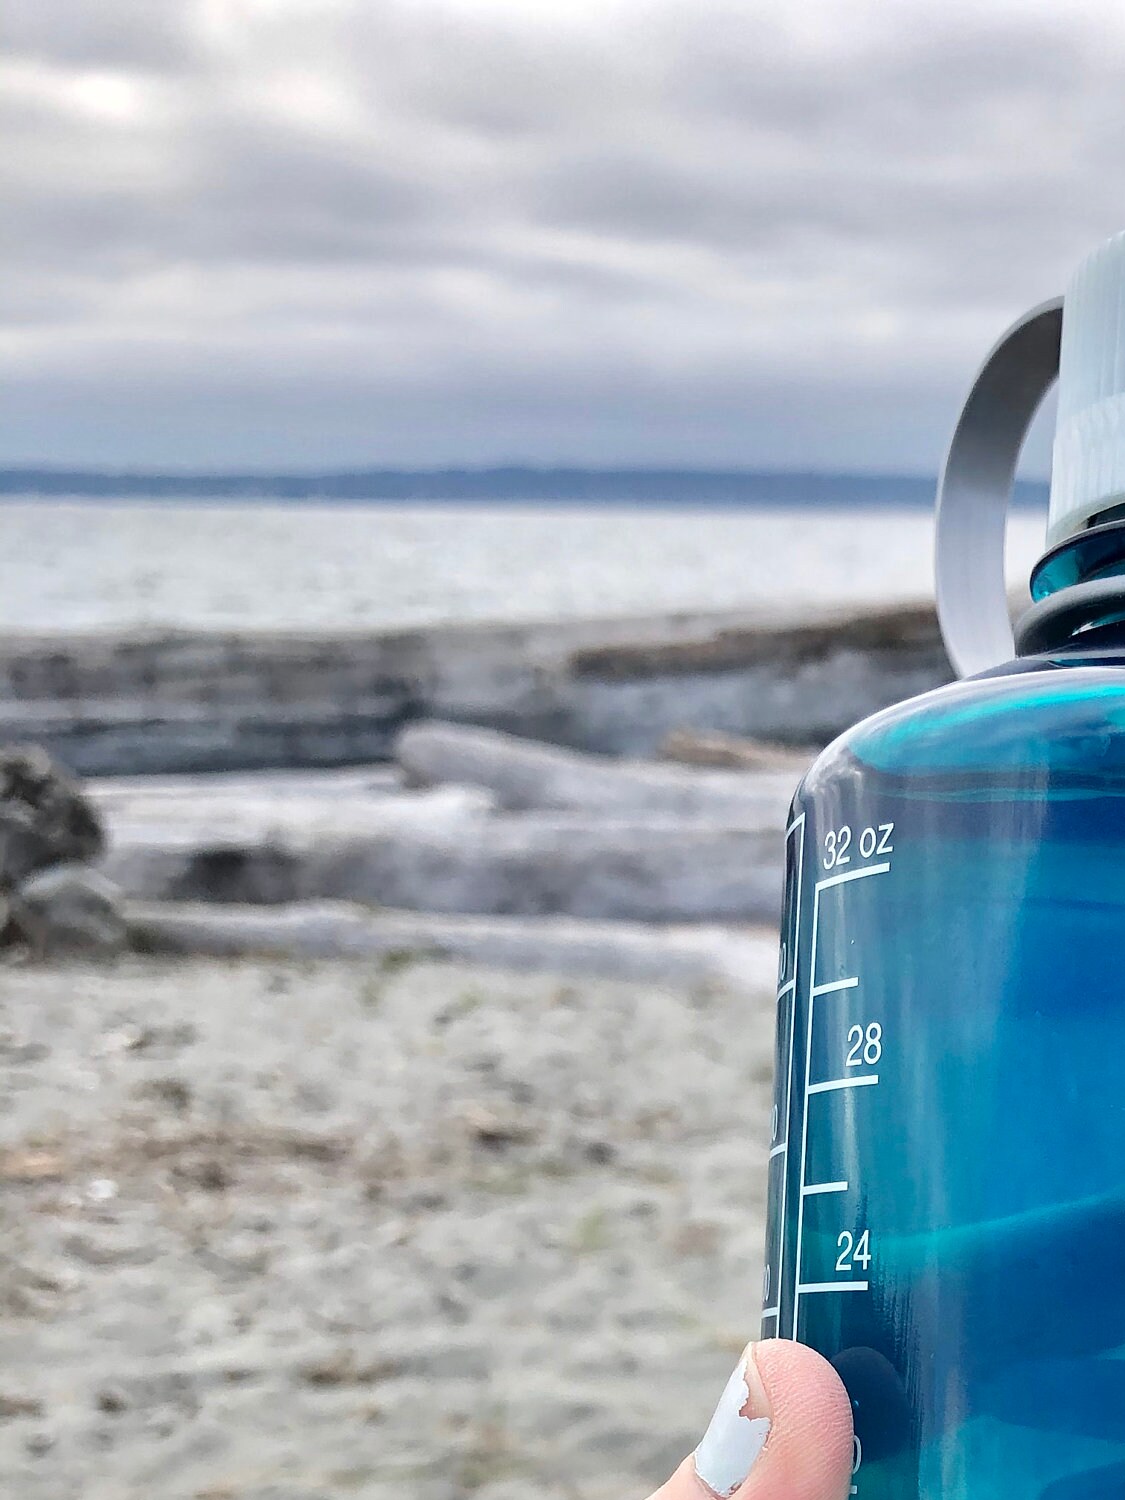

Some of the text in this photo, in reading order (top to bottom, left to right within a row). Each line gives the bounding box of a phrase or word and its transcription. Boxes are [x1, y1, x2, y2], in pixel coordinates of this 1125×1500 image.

[822, 825, 852, 870] 32
[845, 1022, 883, 1067] 28
[835, 1229, 872, 1271] 24
